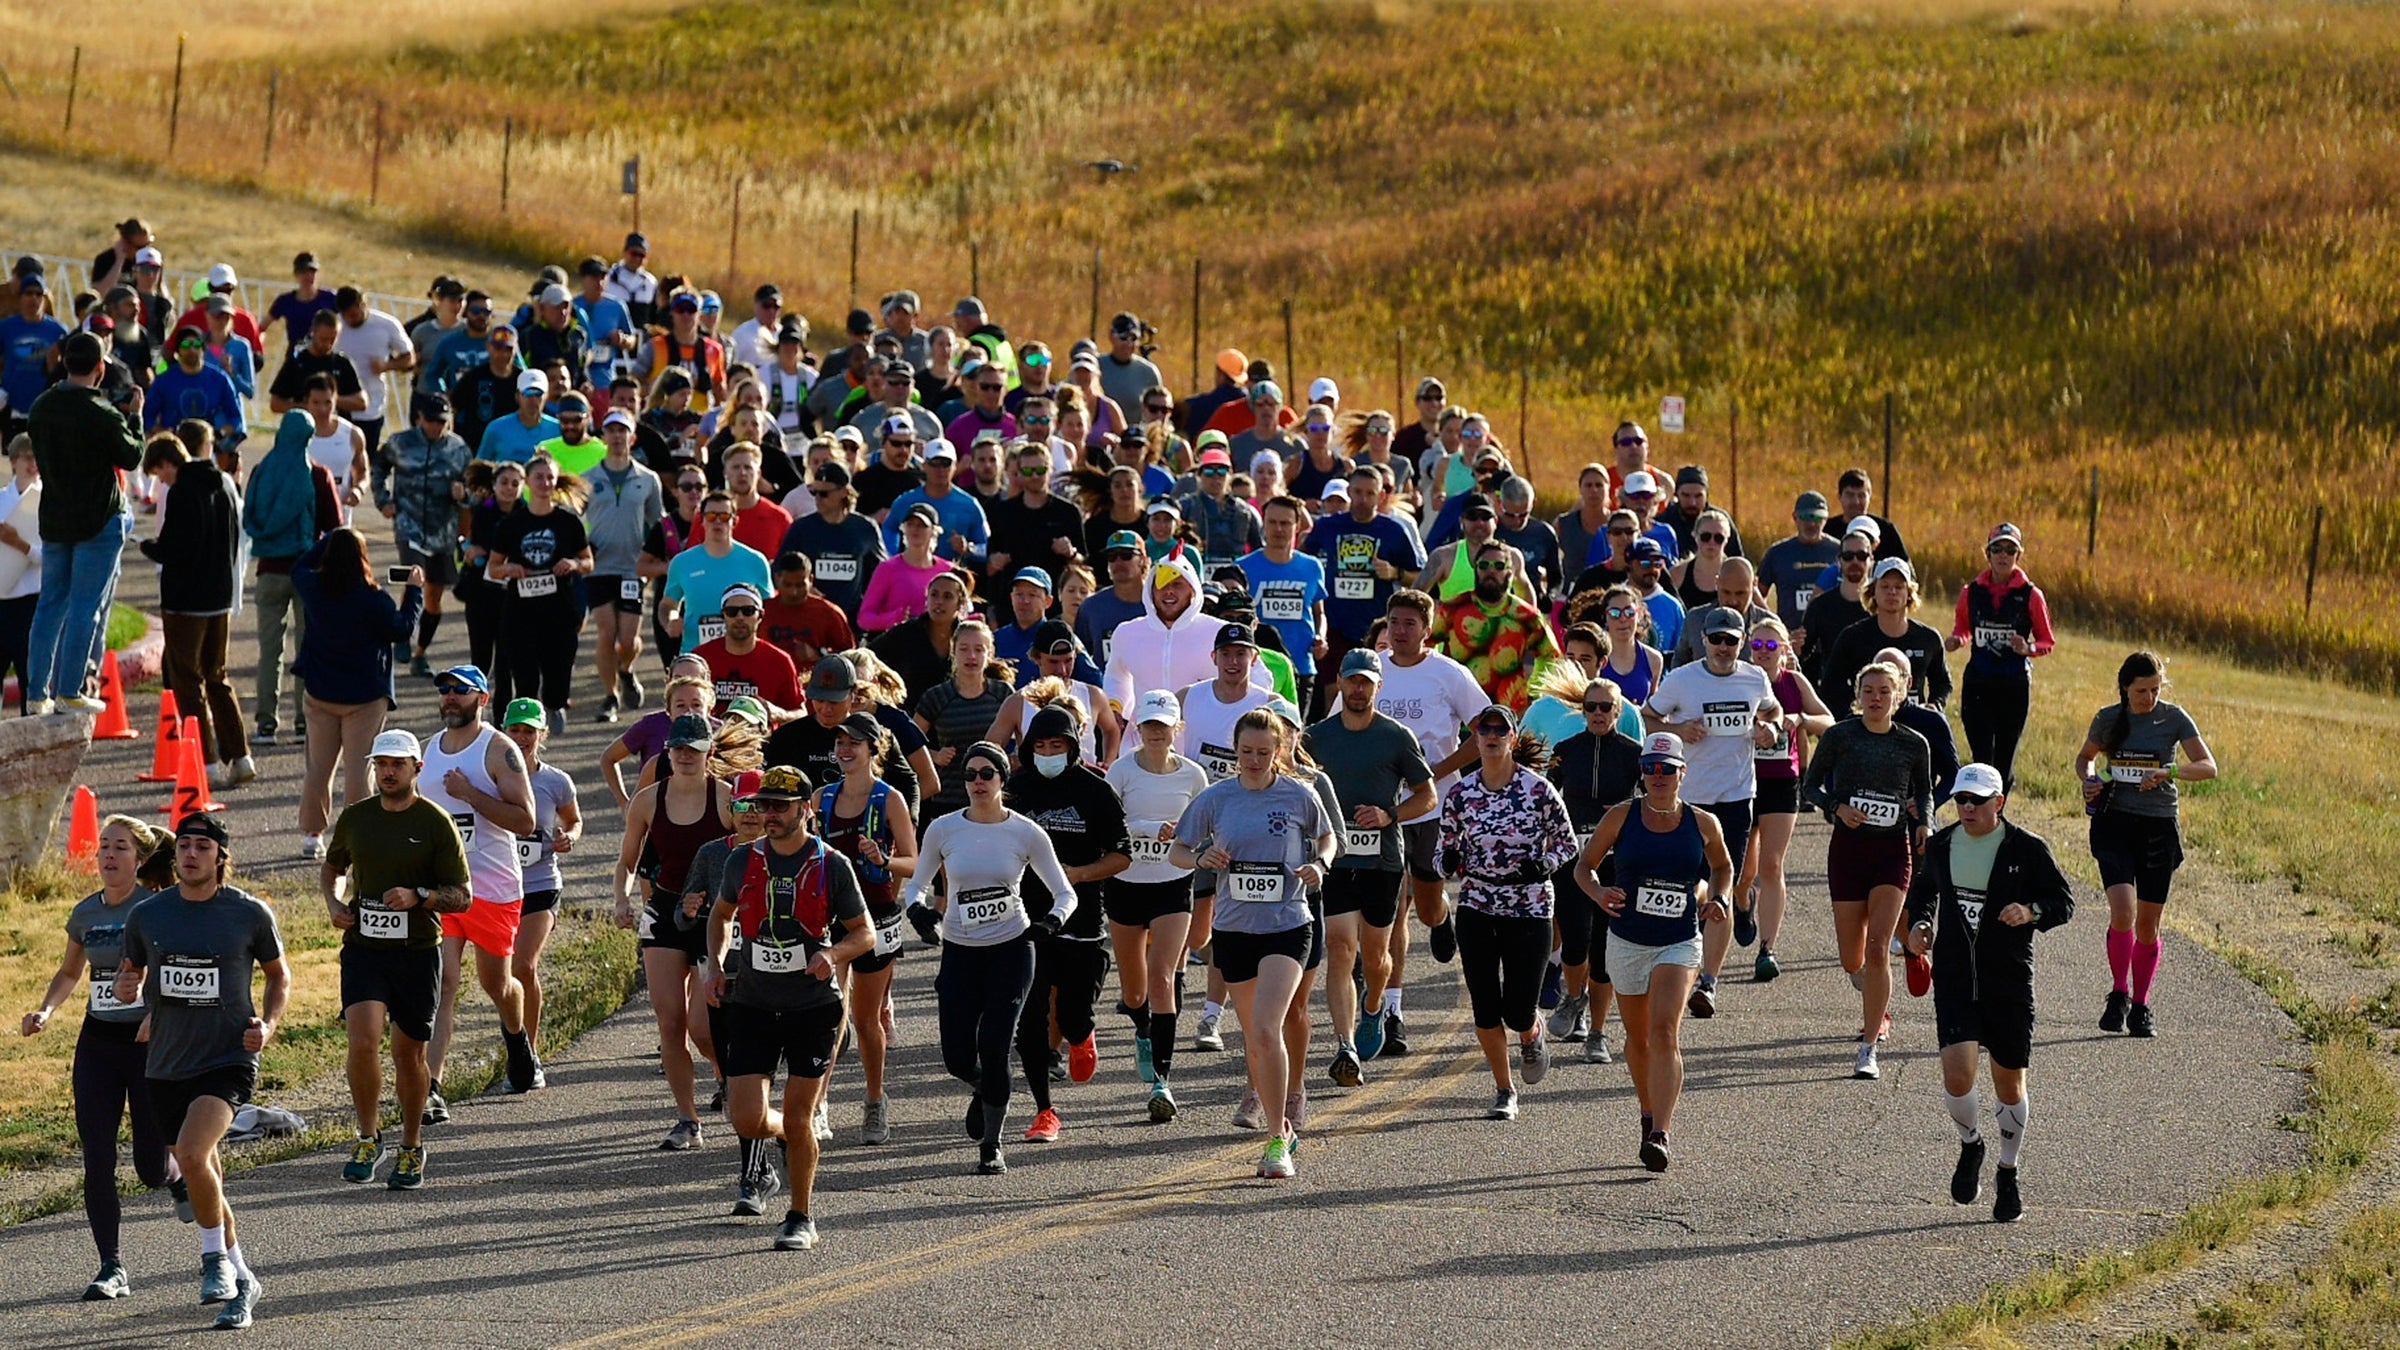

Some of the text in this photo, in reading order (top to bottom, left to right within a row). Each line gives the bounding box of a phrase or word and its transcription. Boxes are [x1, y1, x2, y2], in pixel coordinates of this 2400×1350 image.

[818, 562, 855, 573] 11046
[520, 578, 554, 590] 10244
[1339, 581, 1369, 591] 4727
[1265, 601, 1302, 611] 10658
[714, 684, 759, 697] HICAGO
[1707, 715, 1747, 727] 11061
[1853, 801, 1896, 818] 10221
[1132, 840, 1172, 854] 9107
[1238, 877, 1277, 891] 1089
[1645, 891, 1682, 908] 7692
[967, 901, 1008, 919] 8020
[362, 913, 401, 928] 4220
[762, 950, 792, 963] 339
[164, 970, 215, 987] 10691
[170, 988, 208, 996] Alexander
